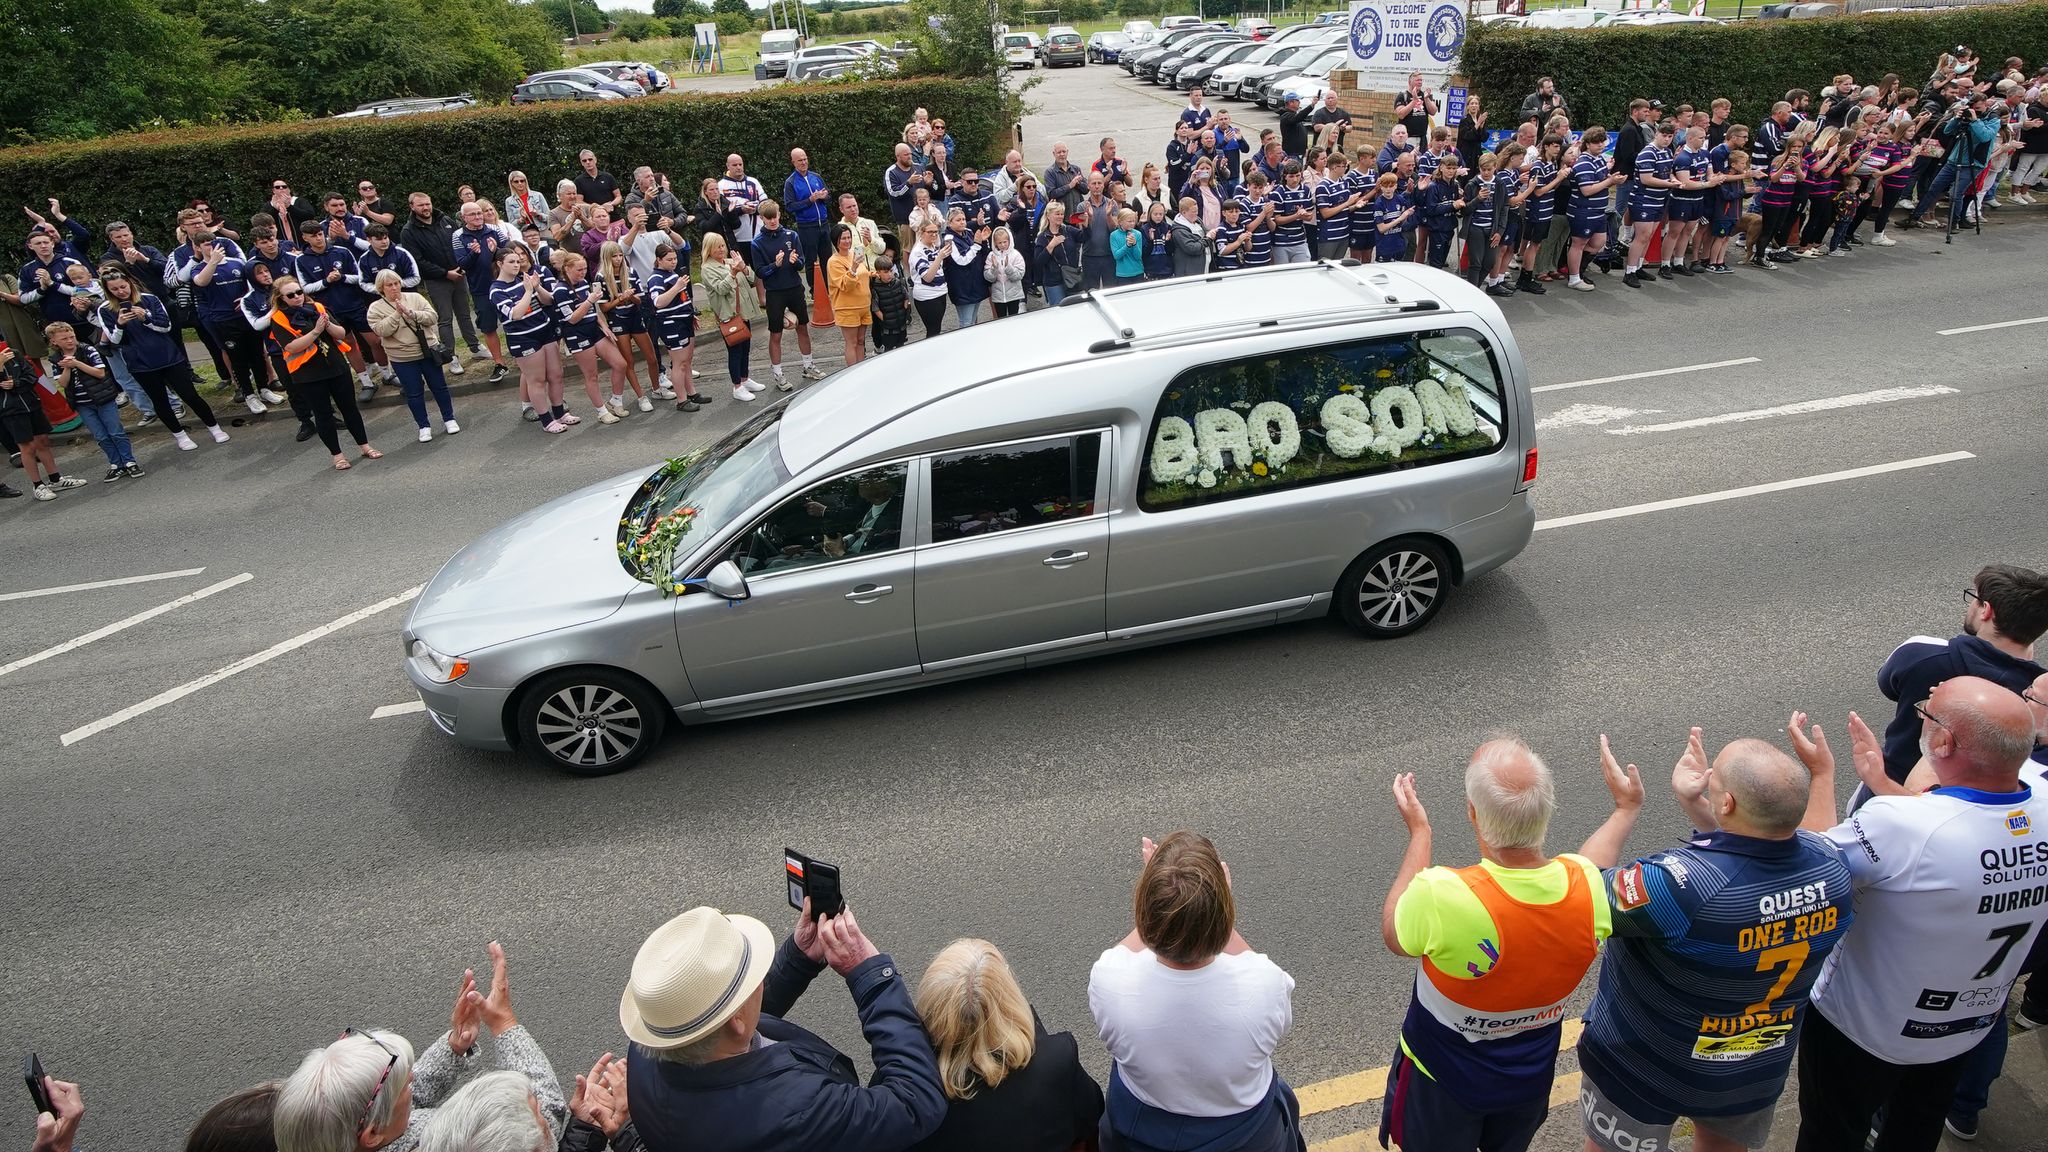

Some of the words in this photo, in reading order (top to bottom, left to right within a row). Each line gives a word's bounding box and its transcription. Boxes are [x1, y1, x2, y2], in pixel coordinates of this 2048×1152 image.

[1386, 4, 1426, 14] WELCOME
[1390, 20, 1399, 28] TO
[1403, 19, 1419, 28] THE
[1386, 33, 1422, 47] LIONS
[1394, 52, 1411, 61] DEN
[1320, 373, 1477, 459] SON
[2009, 816, 2028, 829] NAPA
[1759, 881, 1826, 915] QUEST
[1760, 908, 1800, 924] SOLUTIONS
[1802, 904, 1816, 916] (UK)
[1818, 900, 1830, 910] LTD
[1977, 885, 2048, 914] BURRO
[1738, 920, 1786, 953] ONE
[1792, 906, 1837, 940] ROB
[1970, 920, 2033, 980] 7
[1745, 940, 1810, 1016] 7
[1464, 998, 1570, 1028] #TeamMN
[1726, 1052, 1750, 1060] yellow
[1581, 1088, 1658, 1152] didas
